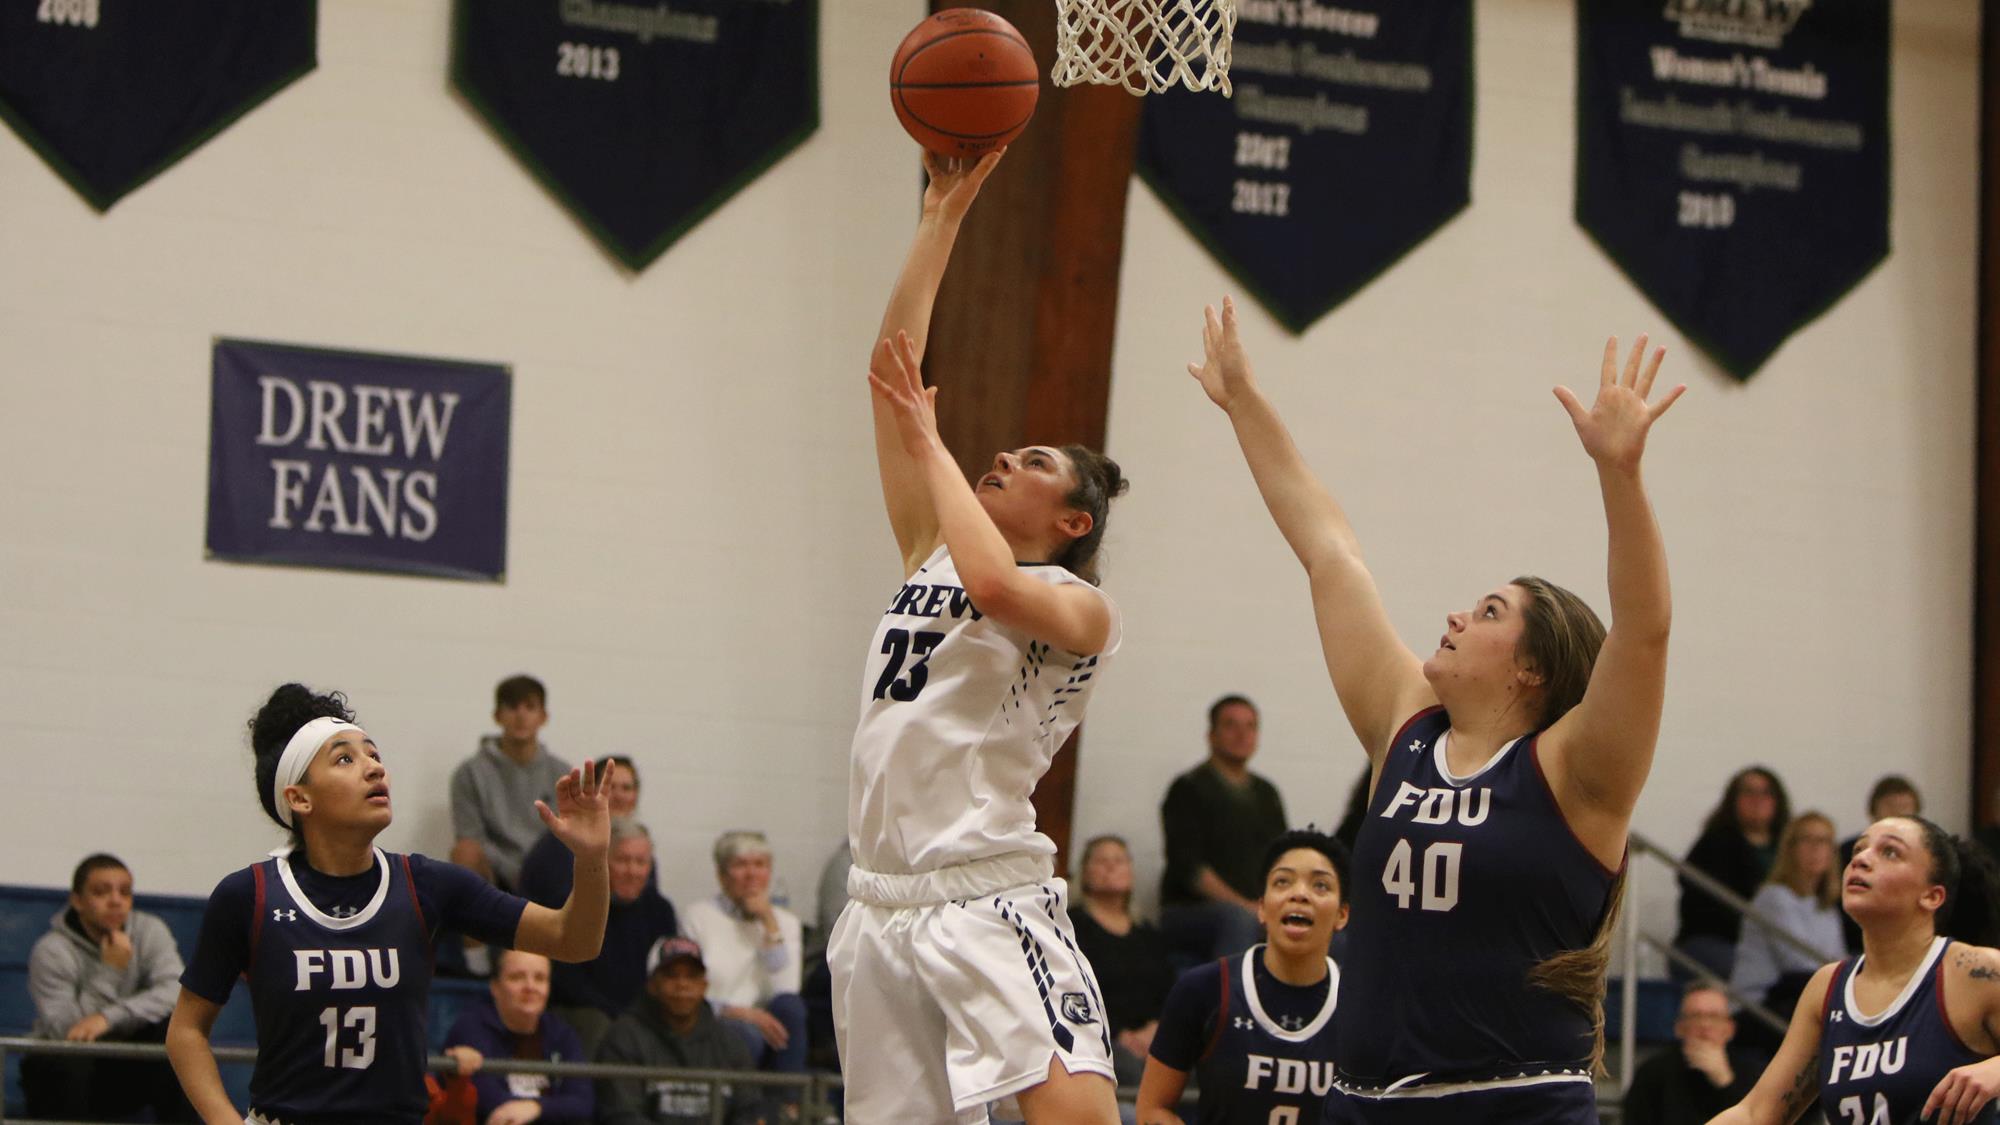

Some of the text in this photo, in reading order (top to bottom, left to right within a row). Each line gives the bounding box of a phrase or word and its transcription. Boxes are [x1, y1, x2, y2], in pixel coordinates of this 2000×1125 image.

[557, 42, 621, 81] 2013
[256, 376, 459, 461] DREW
[268, 458, 439, 542] FANS
[872, 628, 946, 702] 23
[1380, 780, 1491, 827] FDU
[1381, 838, 1463, 912] 40
[292, 948, 400, 991] FDU
[319, 1006, 377, 1070] 13
[1828, 1036, 1908, 1085] FDU
[1244, 1053, 1334, 1097] FDU
